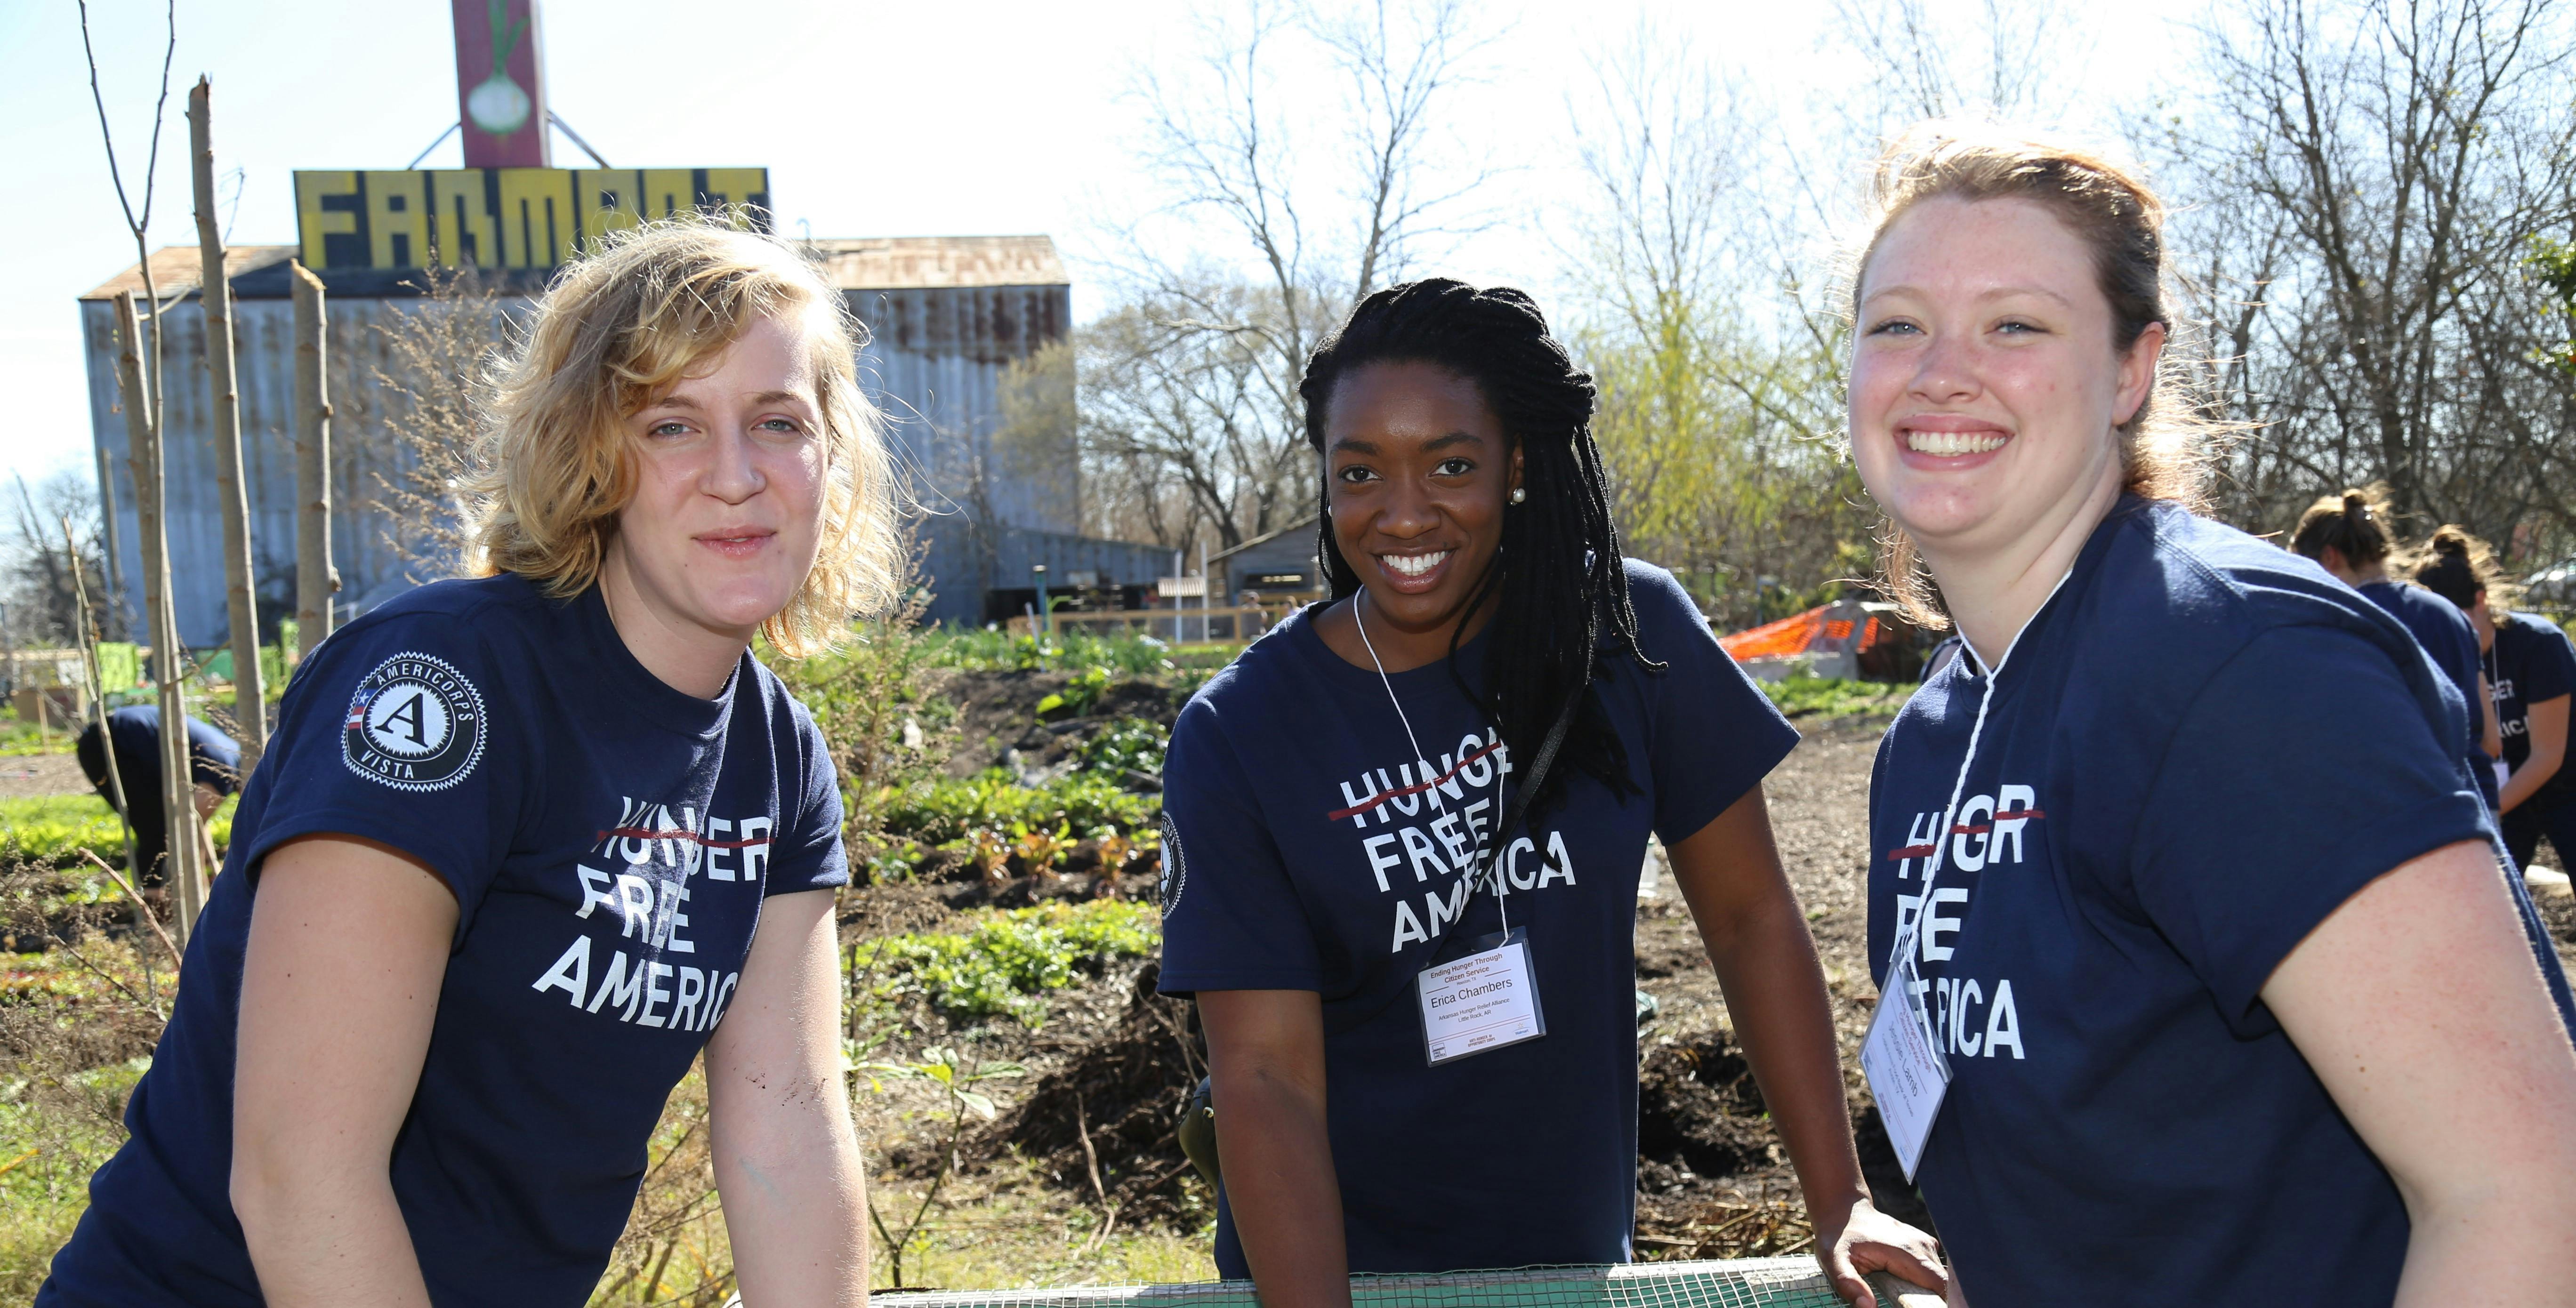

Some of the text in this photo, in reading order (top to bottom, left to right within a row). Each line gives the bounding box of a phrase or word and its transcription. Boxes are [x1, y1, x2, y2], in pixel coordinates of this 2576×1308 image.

[377, 663, 474, 721] AMERICORPS
[375, 692, 428, 748] A
[361, 750, 414, 779] VISTA
[1340, 727, 1513, 829] HUNGE
[1362, 797, 1490, 892] FREE
[575, 863, 695, 953] FREE
[531, 934, 738, 1032] AMERIC
[1431, 953, 1503, 979] Ending Hunger Through
[1444, 966, 1489, 983] Citizen Service
[1431, 979, 1512, 1008] Erica Chambers
[1439, 998, 1510, 1021] Arkansas Hunger Relief Alliance
[1902, 1059, 1918, 1097] Lamb
